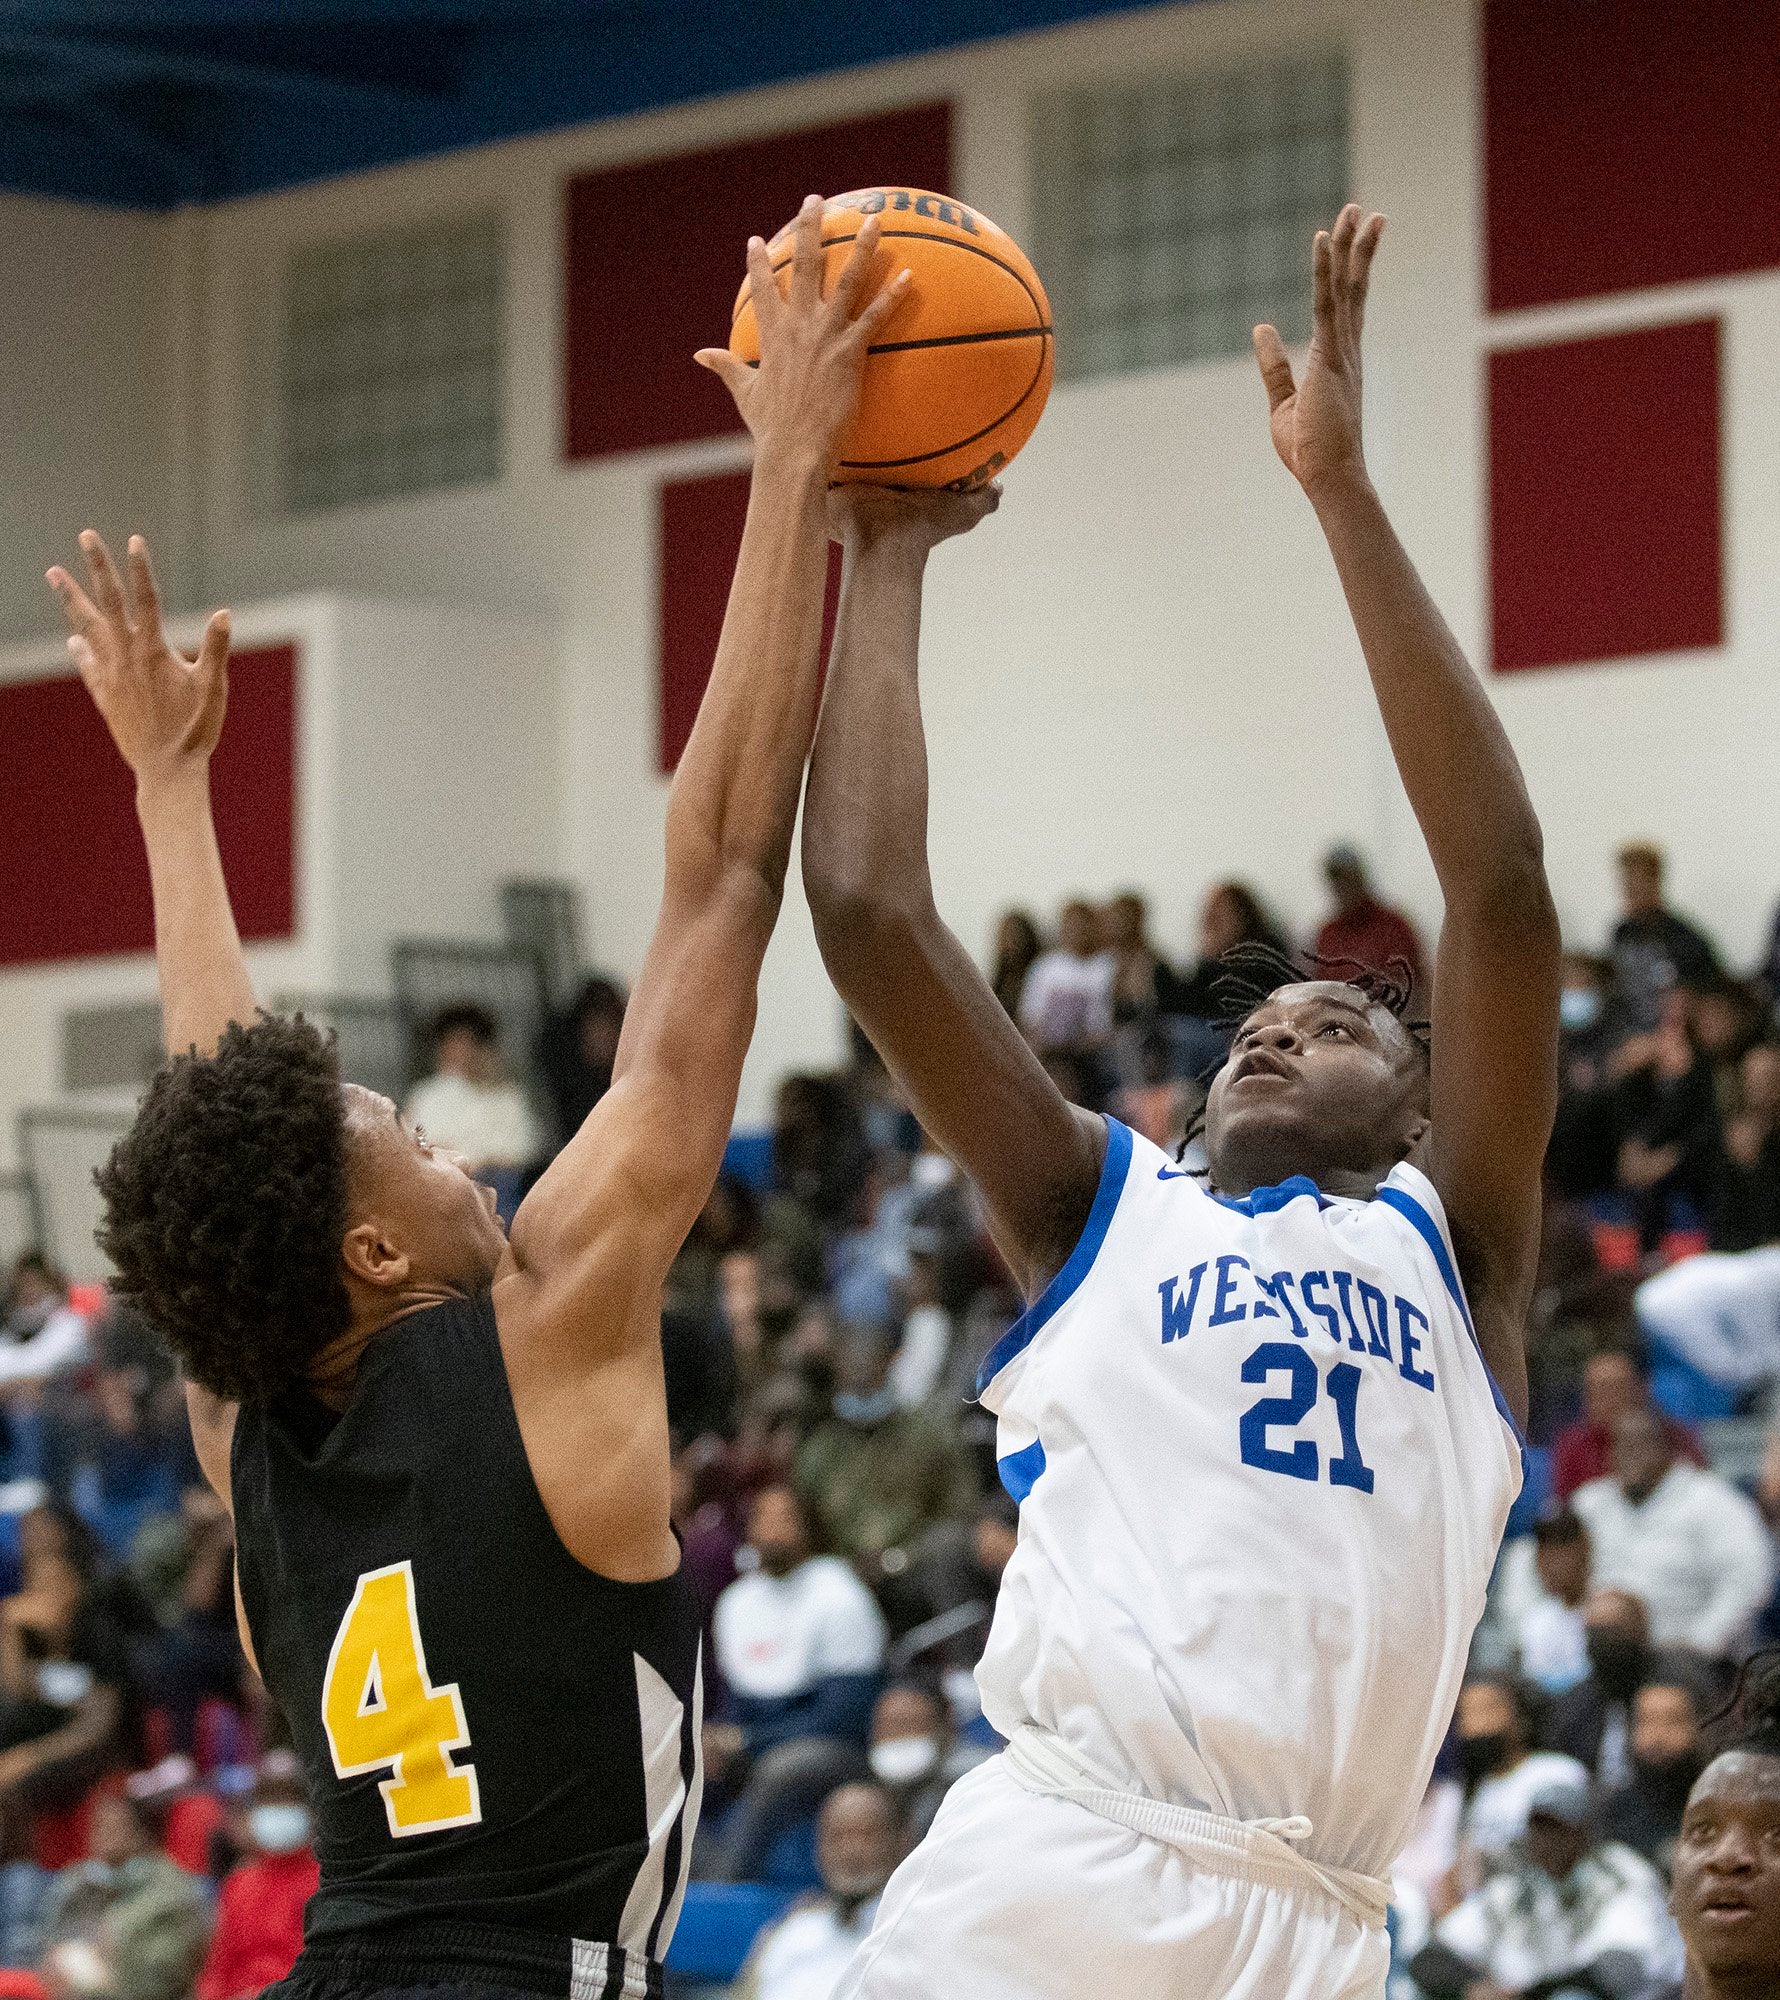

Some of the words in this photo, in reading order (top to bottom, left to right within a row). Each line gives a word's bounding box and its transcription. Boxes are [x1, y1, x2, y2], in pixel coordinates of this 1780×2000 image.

[820, 190, 980, 237] Wil
[1239, 1342, 1375, 1495] 21
[321, 1560, 483, 1839] 4
